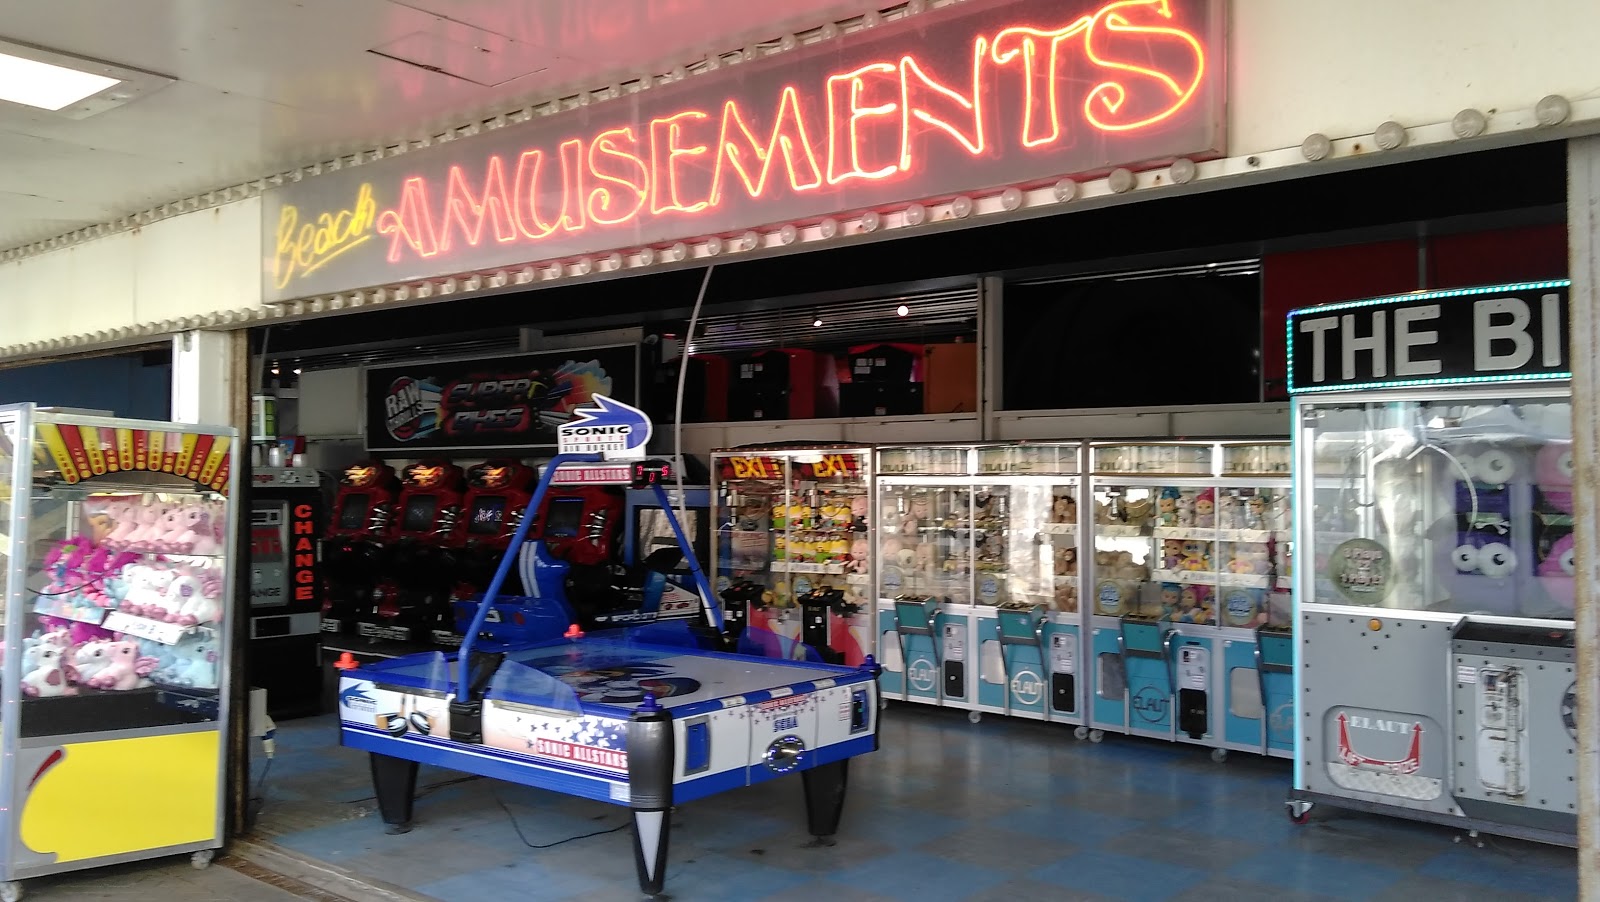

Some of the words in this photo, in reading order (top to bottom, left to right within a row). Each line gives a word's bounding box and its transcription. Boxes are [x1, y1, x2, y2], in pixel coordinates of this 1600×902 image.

[273, 182, 377, 290] Beach
[376, 0, 1204, 263] AMUSEMENTS
[1300, 304, 1442, 382] THE
[385, 382, 421, 418] RAW
[562, 426, 629, 436] SONIC
[587, 443, 625, 451] HOCKEY
[553, 470, 582, 481] SONIC
[584, 469, 630, 480] ALLSTARS
[294, 504, 314, 600] CHANGE
[773, 716, 799, 733] SEGA
[1350, 716, 1411, 734] ELAUT
[537, 740, 571, 757] SONIC
[573, 746, 628, 768] ALLSTARS
